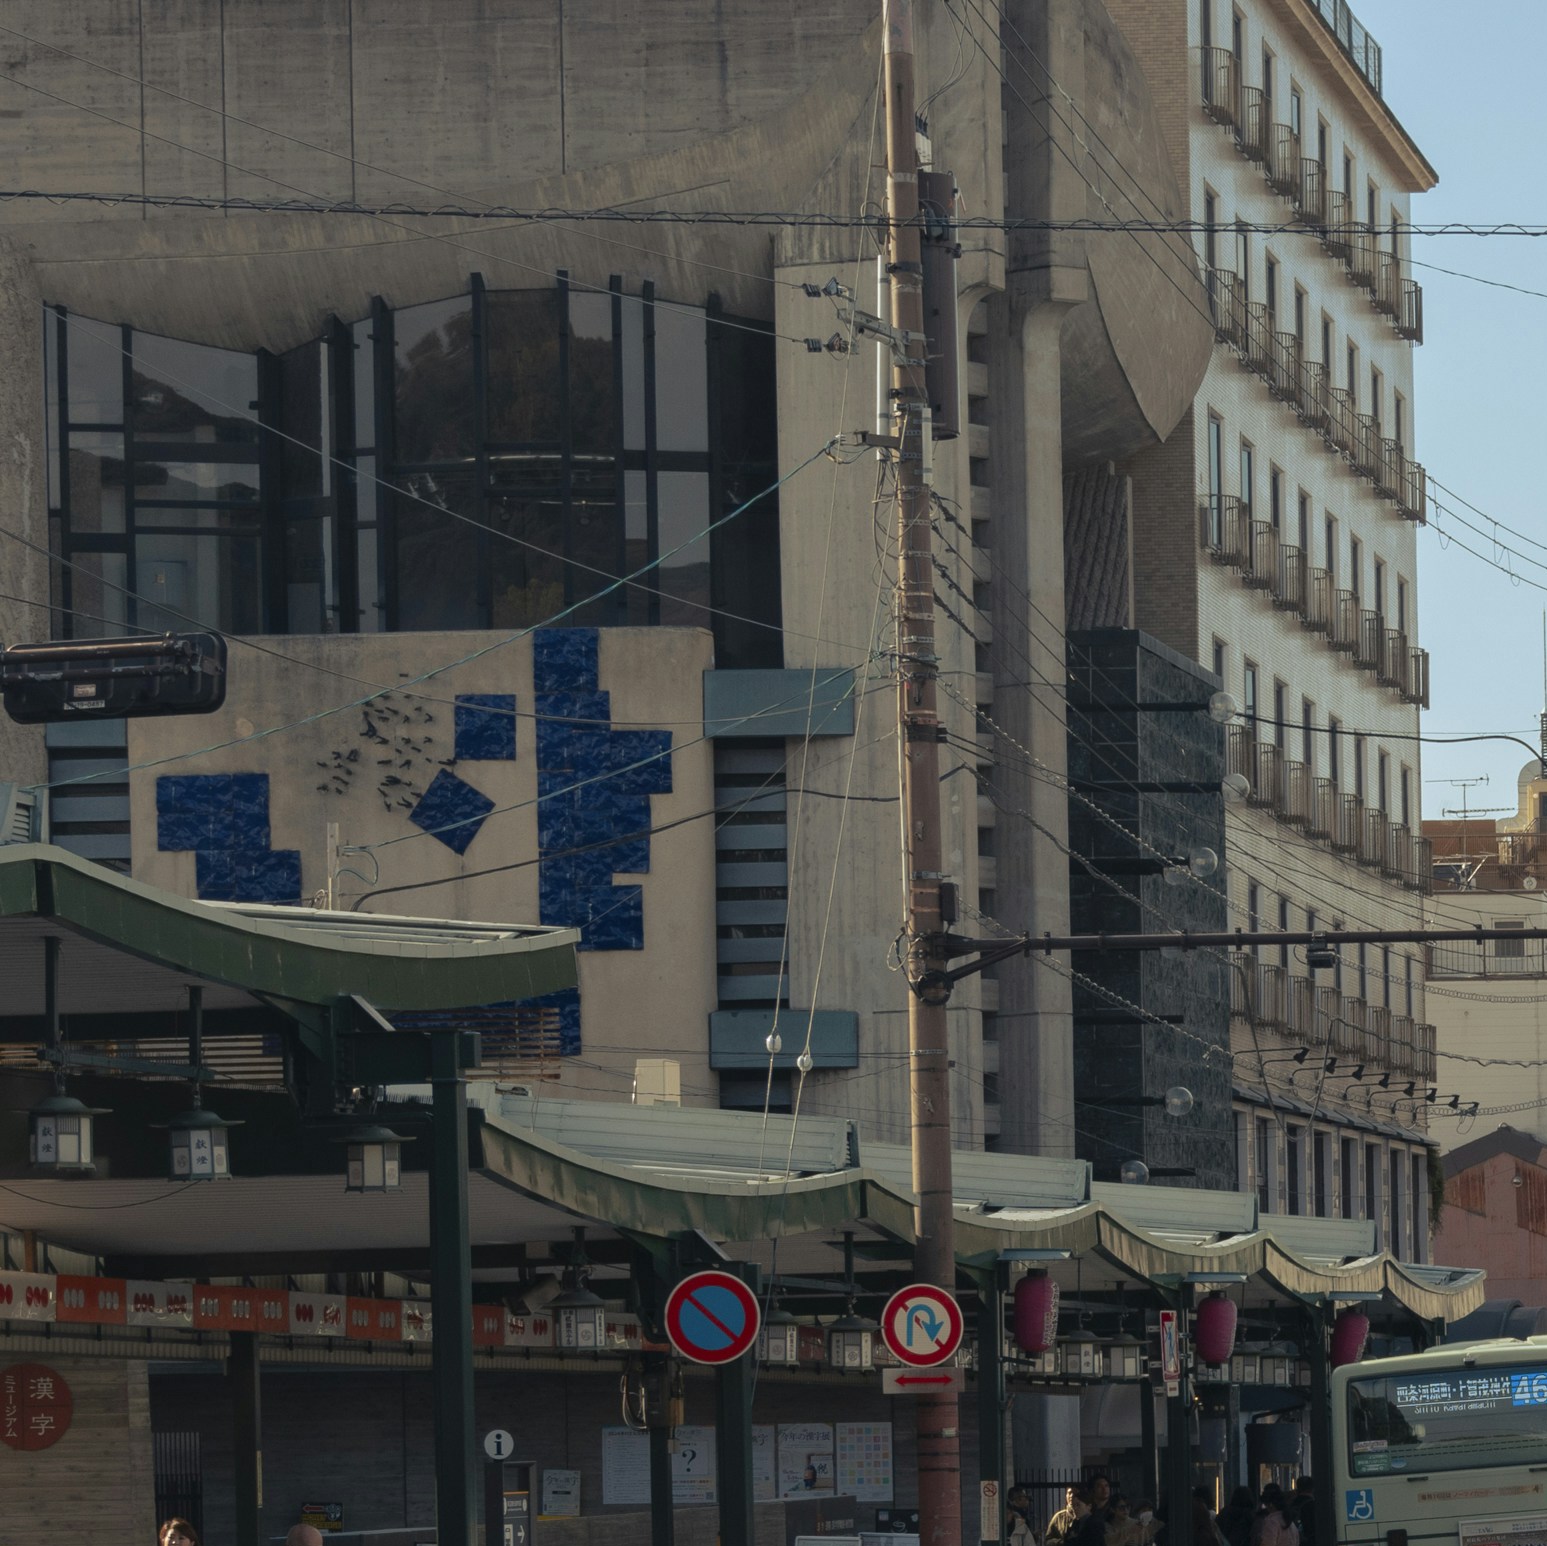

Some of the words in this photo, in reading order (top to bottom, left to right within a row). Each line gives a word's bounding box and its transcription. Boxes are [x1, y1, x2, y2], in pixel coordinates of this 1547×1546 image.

[4, 1375, 18, 1437] ミュージアム
[29, 1377, 56, 1436] 漢字
